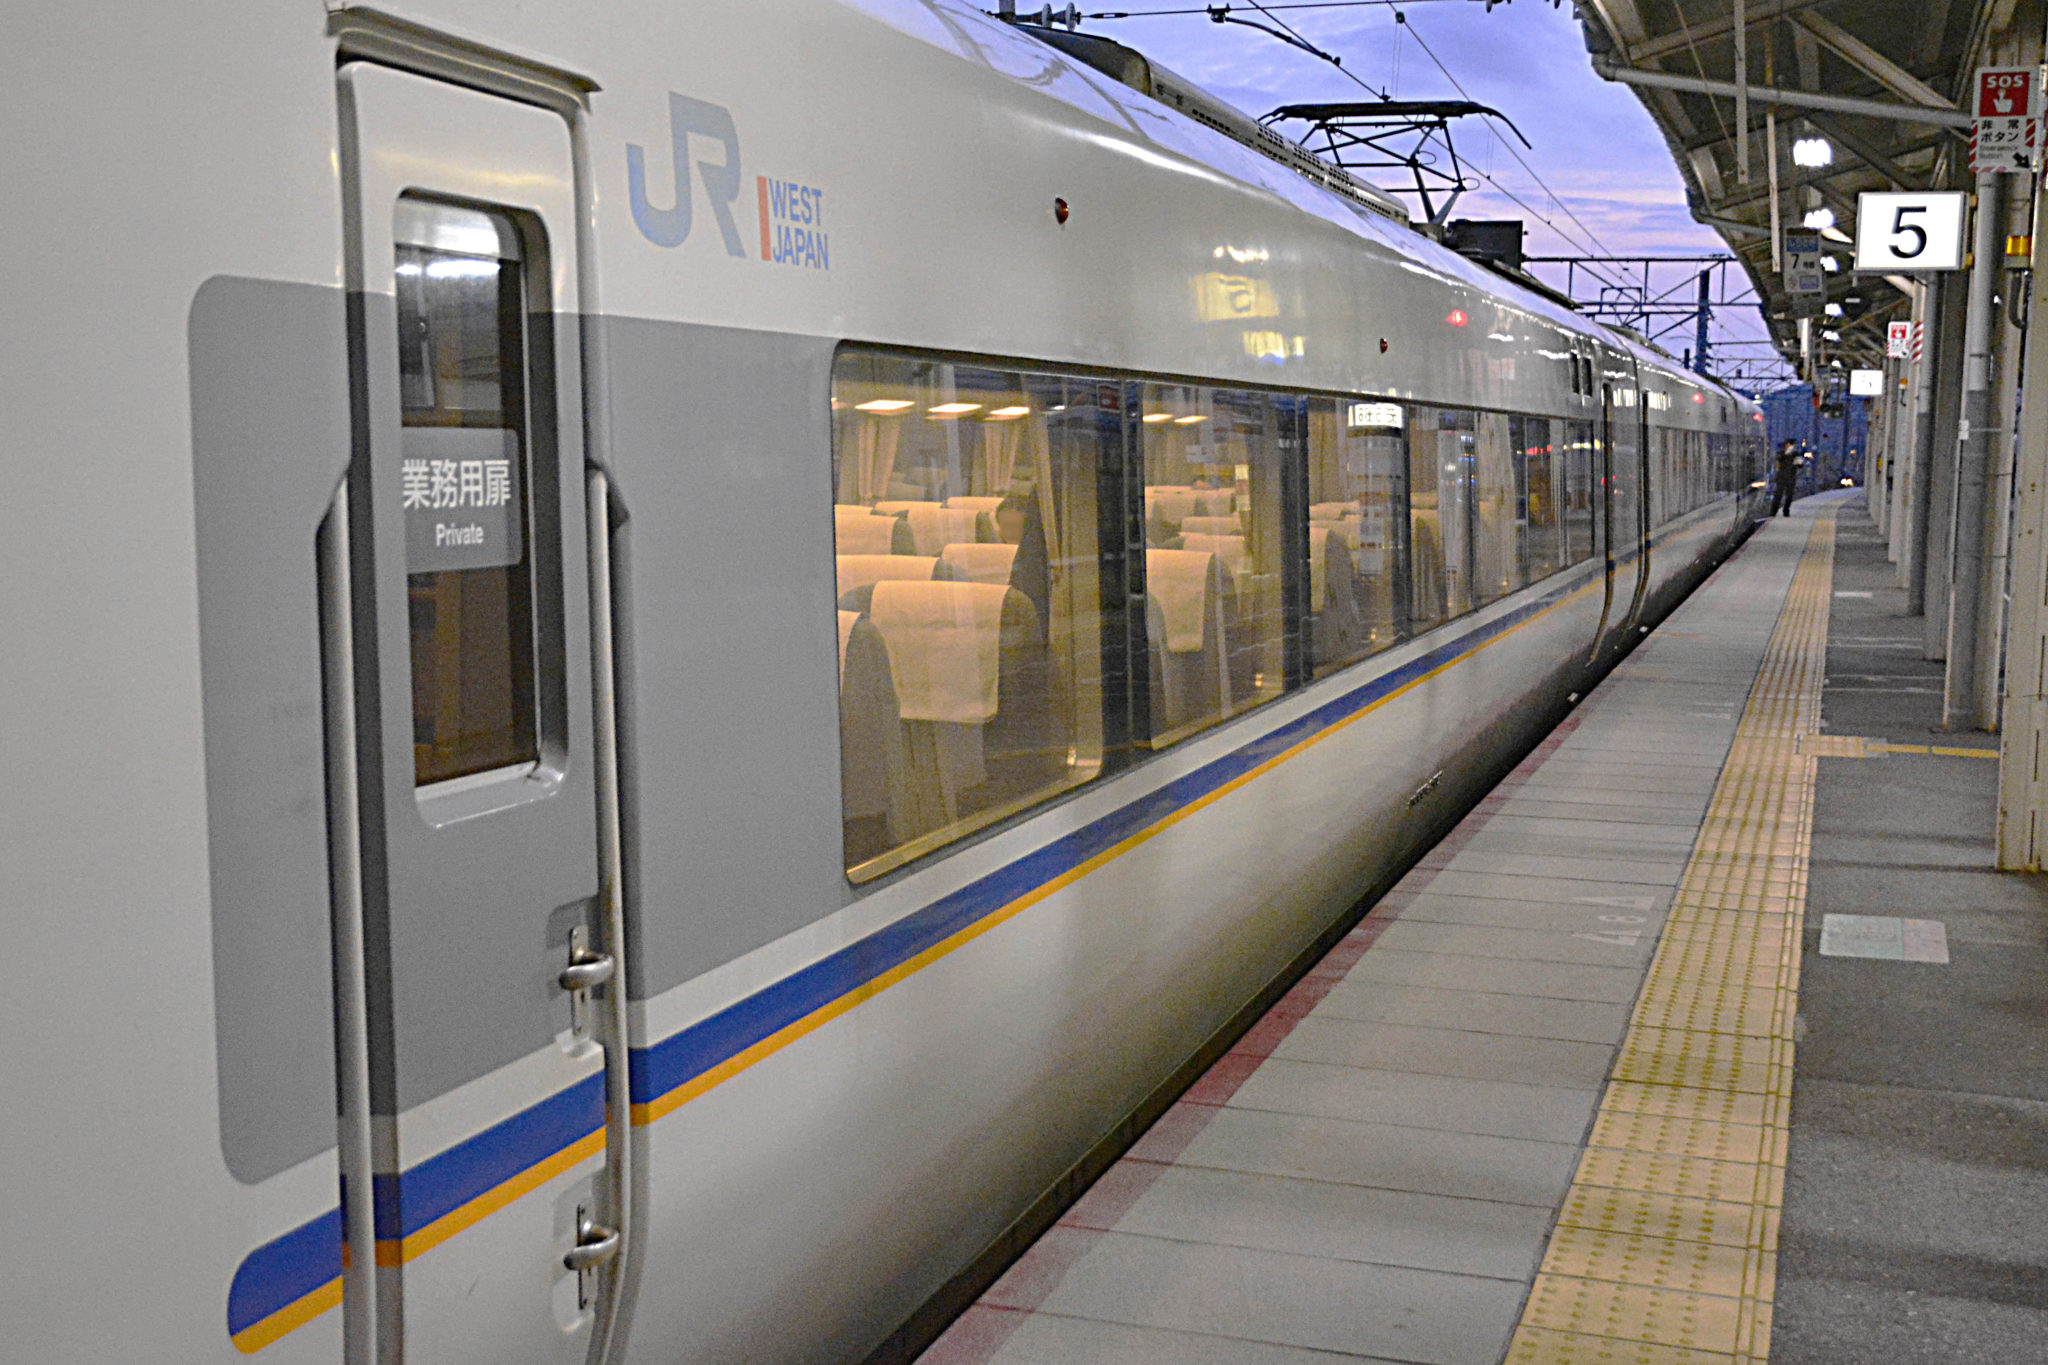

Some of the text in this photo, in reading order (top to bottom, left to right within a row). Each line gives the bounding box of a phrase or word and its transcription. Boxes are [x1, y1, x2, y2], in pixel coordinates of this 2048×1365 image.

[1986, 75, 2024, 88] SOS
[1981, 131, 2019, 142] ボタン
[625, 90, 747, 259] JR
[769, 177, 823, 227] WEST
[772, 224, 829, 271] JAPAN
[1888, 206, 1927, 259] 5
[1791, 253, 1800, 269] 7
[401, 459, 512, 509] 業務用扉
[435, 522, 484, 547] Private
